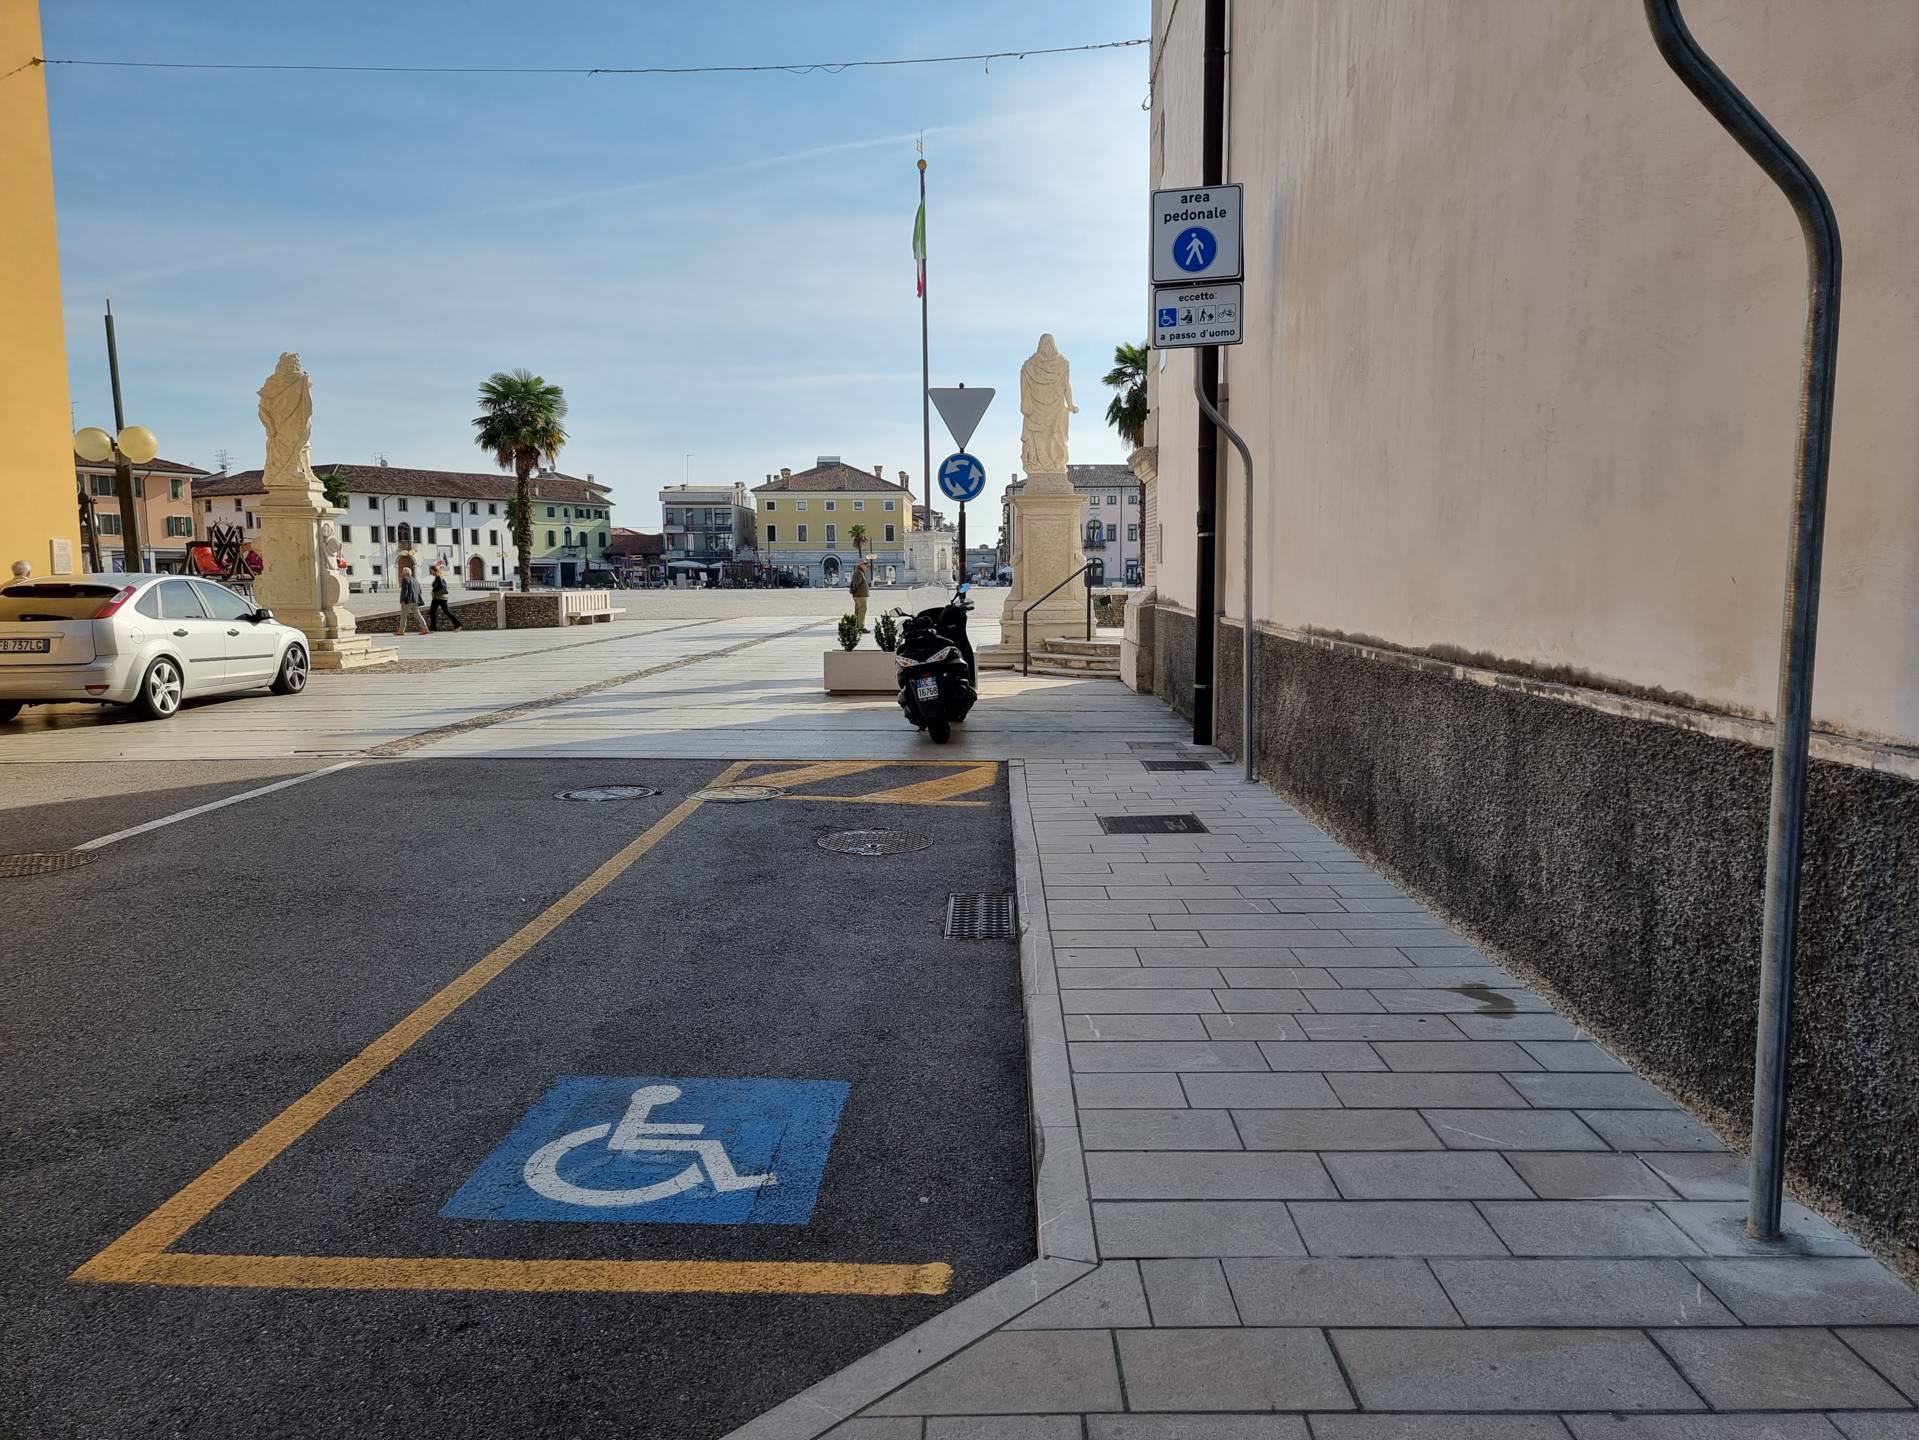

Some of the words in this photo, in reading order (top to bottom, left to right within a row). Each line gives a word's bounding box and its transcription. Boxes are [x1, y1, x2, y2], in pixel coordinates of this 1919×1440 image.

[1180, 193, 1210, 204] area
[1164, 207, 1227, 224] pedonale
[1160, 333, 1166, 341] a
[1169, 331, 1197, 342] passo
[1199, 328, 1235, 338] d'uomo
